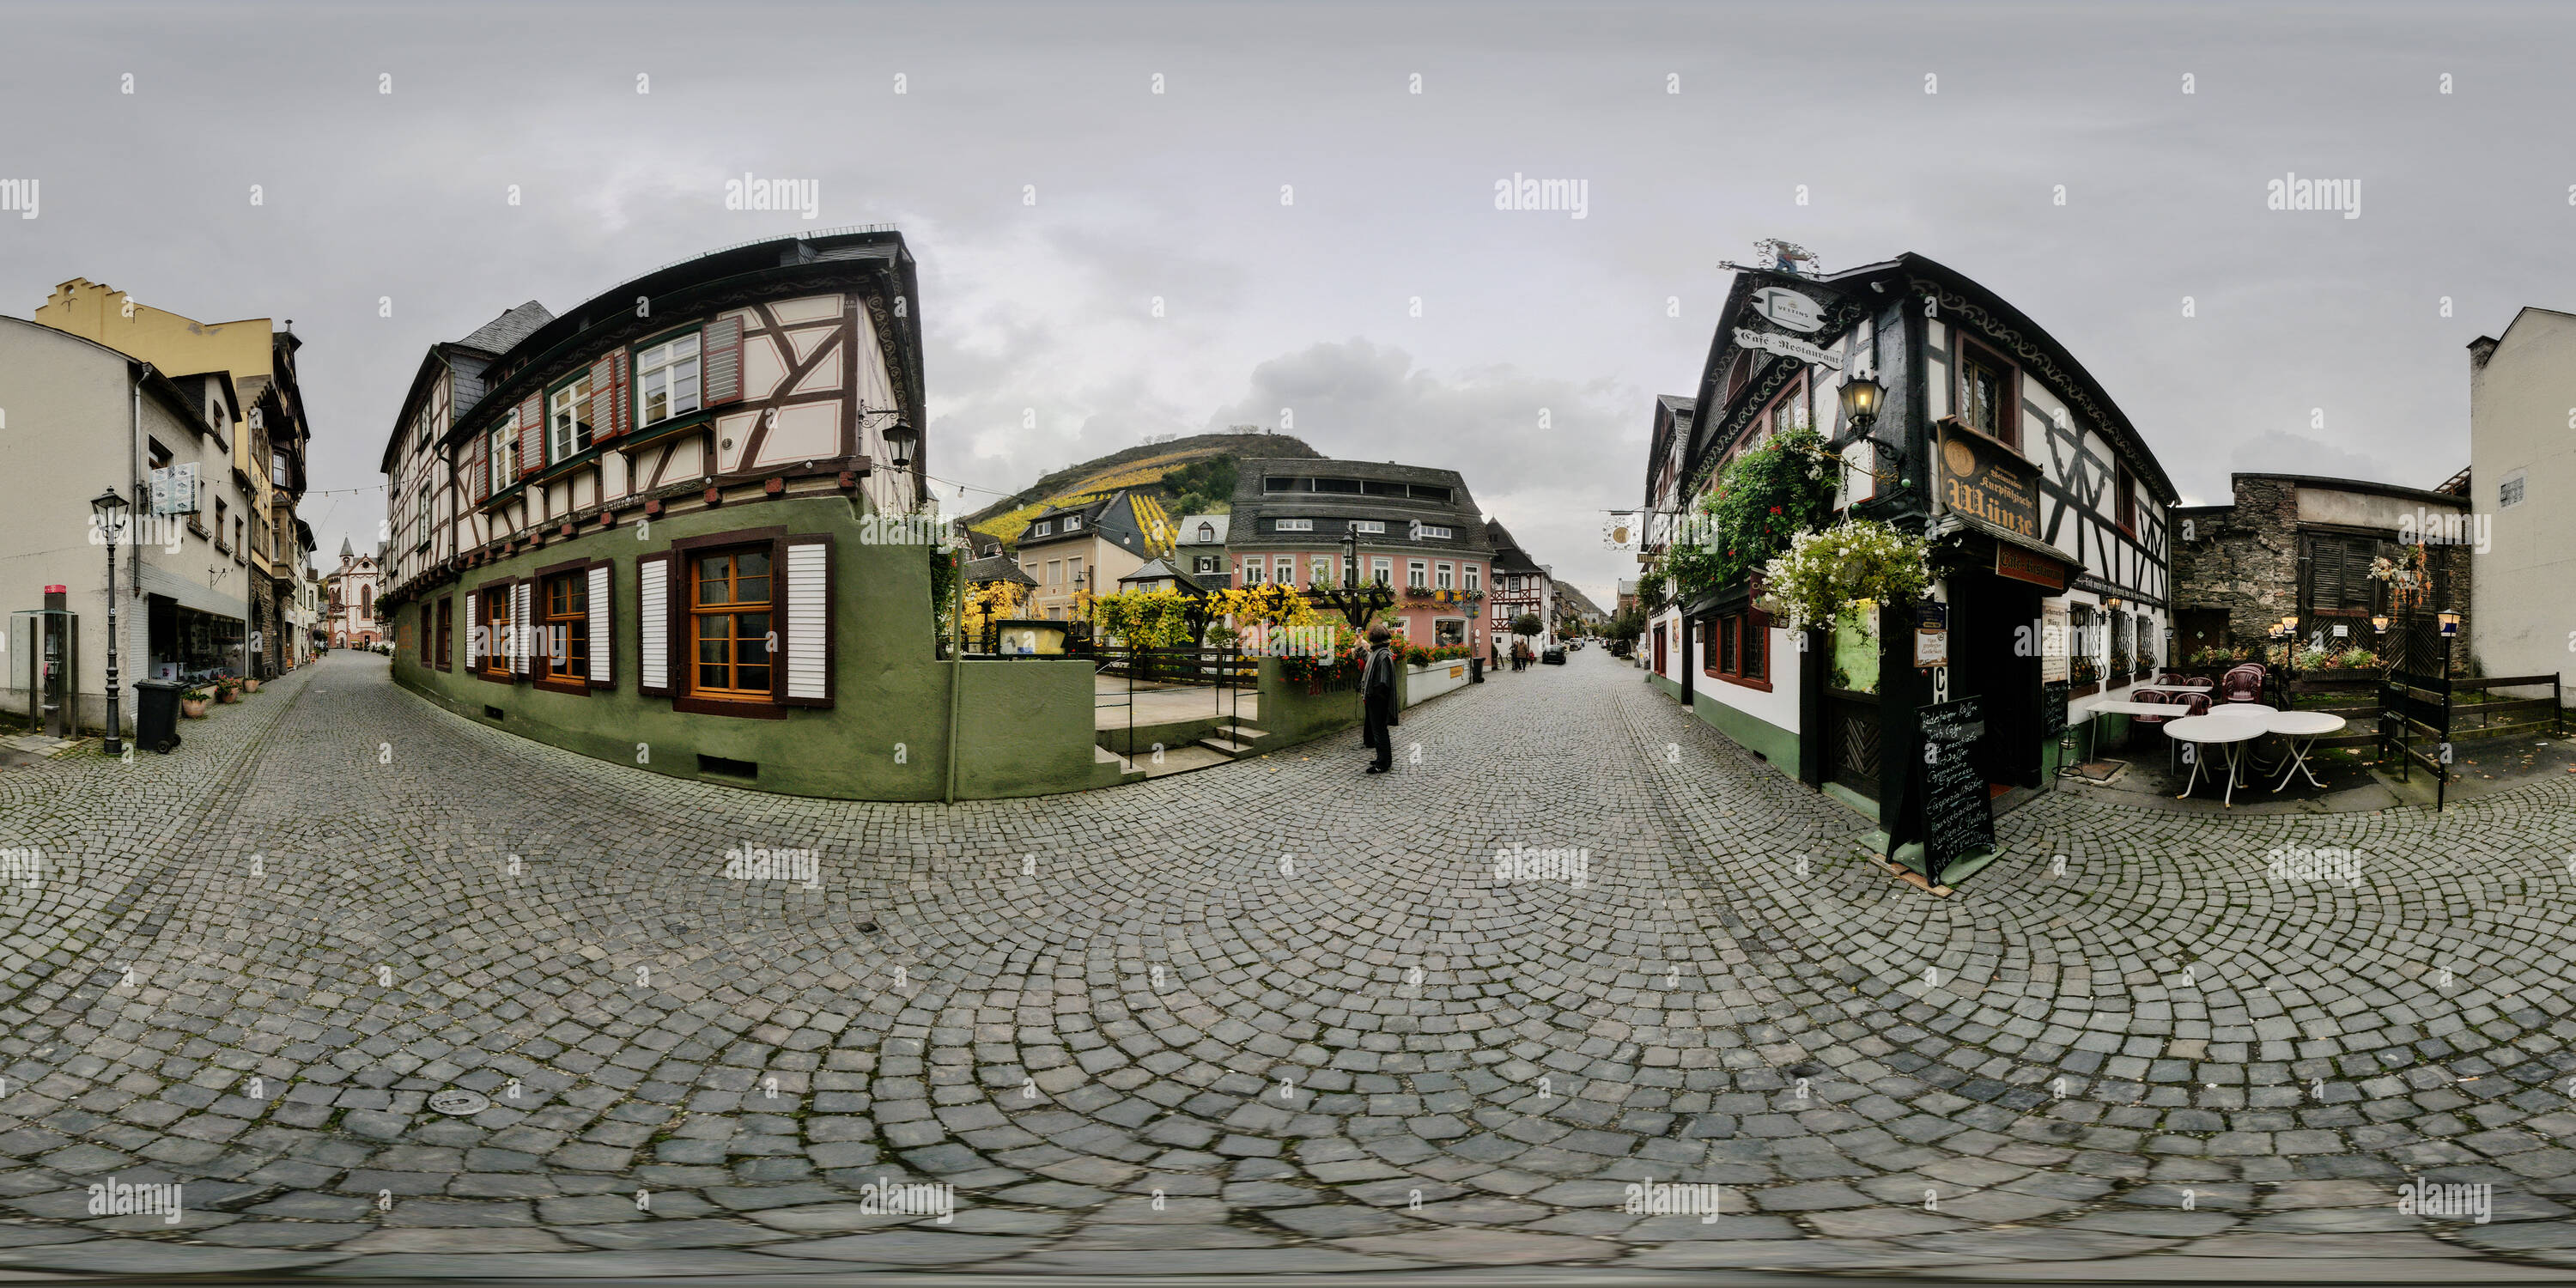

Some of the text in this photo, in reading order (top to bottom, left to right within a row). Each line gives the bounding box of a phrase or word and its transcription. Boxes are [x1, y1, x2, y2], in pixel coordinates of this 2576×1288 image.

[1741, 331, 1769, 347] Café
[1778, 339, 1839, 364] Restaurant
[1947, 478, 2034, 536] Münze
[1980, 477, 2033, 508] Kurpfälzische
